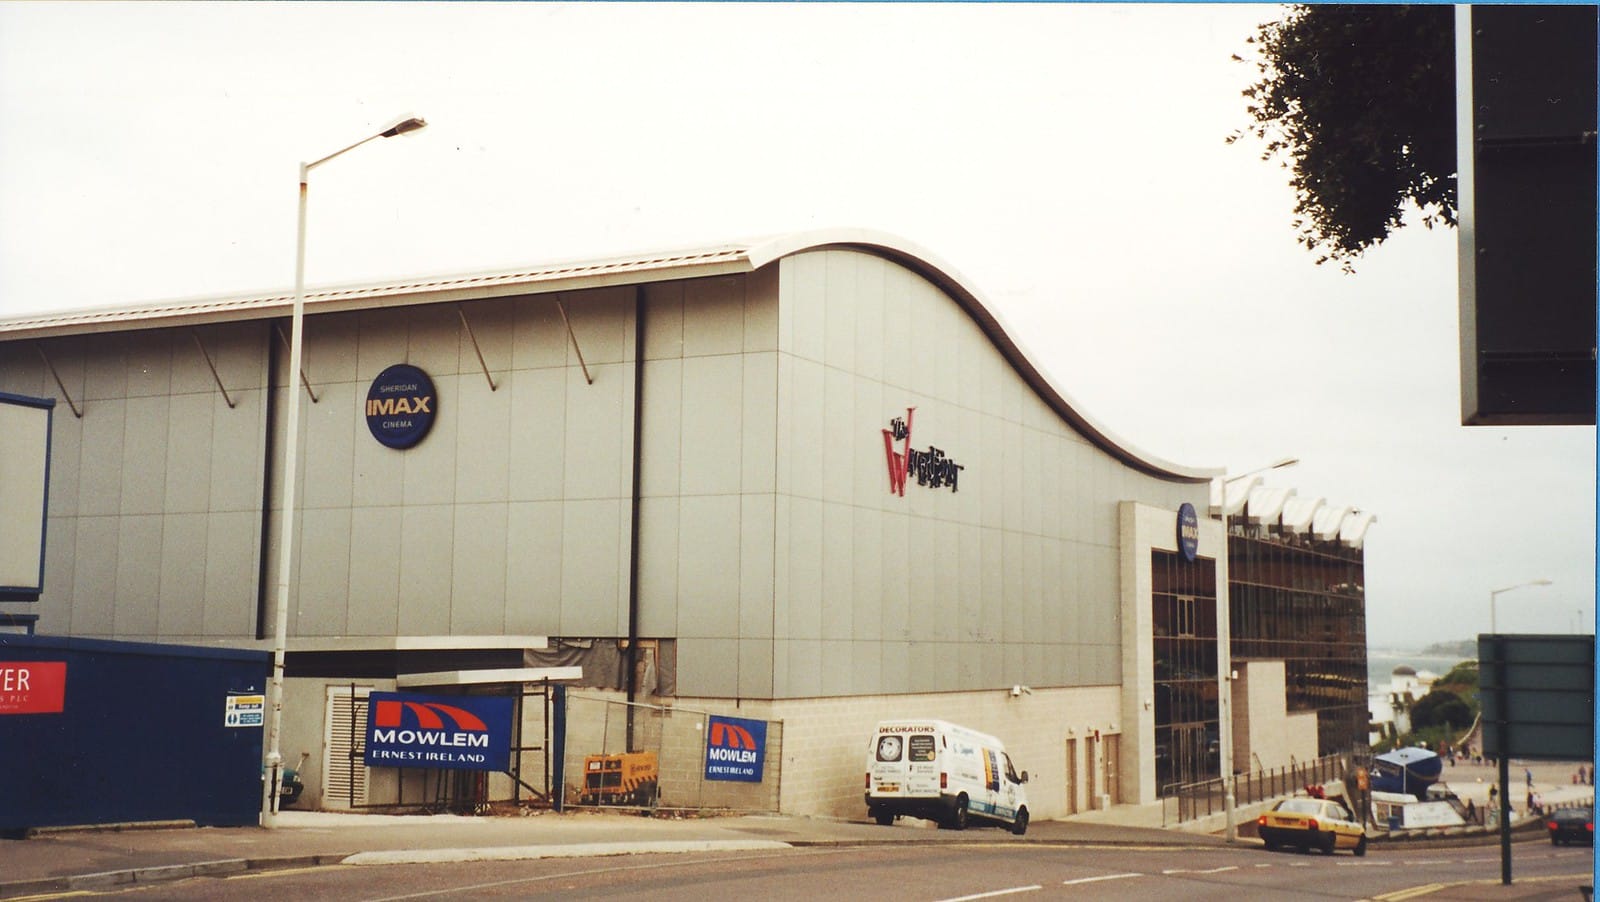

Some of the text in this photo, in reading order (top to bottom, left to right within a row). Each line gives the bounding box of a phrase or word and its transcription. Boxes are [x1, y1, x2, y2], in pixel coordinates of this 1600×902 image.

[380, 384, 418, 393] SHERIDAN
[367, 396, 431, 416] IMAX
[382, 420, 412, 429] CINEMA
[374, 729, 489, 747] MOWLEM
[372, 749, 485, 763] ERNEST IRELAND
[709, 747, 757, 764] MOWLEM
